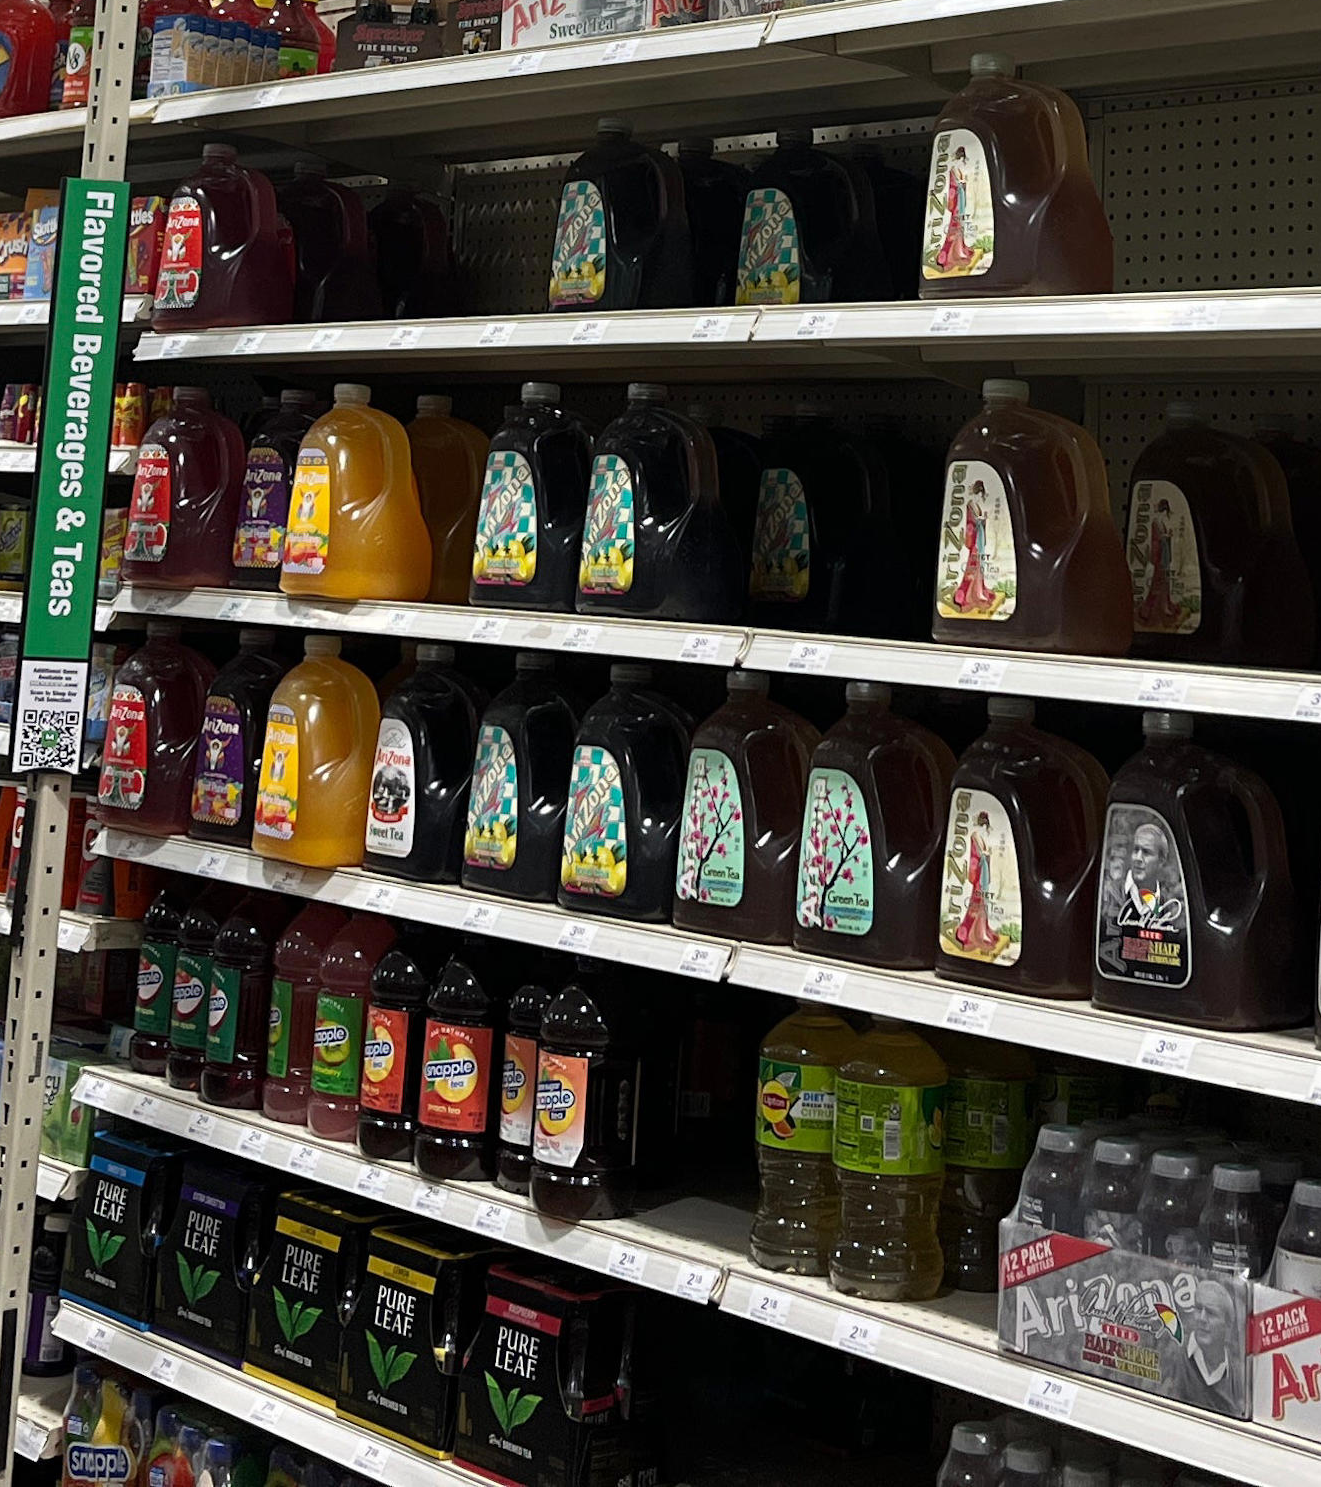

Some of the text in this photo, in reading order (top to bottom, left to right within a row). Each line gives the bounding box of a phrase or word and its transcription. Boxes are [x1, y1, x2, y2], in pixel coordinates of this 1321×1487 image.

[548, 19, 588, 40] Sweet
[357, 43, 419, 55] FIRE BREWED
[49, 190, 116, 618] Flavored Beverages & Teas
[426, 1061, 475, 1078] snapple
[763, 1094, 787, 1111] Lipton
[802, 1092, 826, 1104] DIET
[1003, 1239, 1055, 1276] 12 PACK
[377, 1284, 416, 1317] PURE
[1258, 1305, 1309, 1339] 12 PACK
[497, 1325, 540, 1358] PURE
[69, 1446, 133, 1481] snapple
